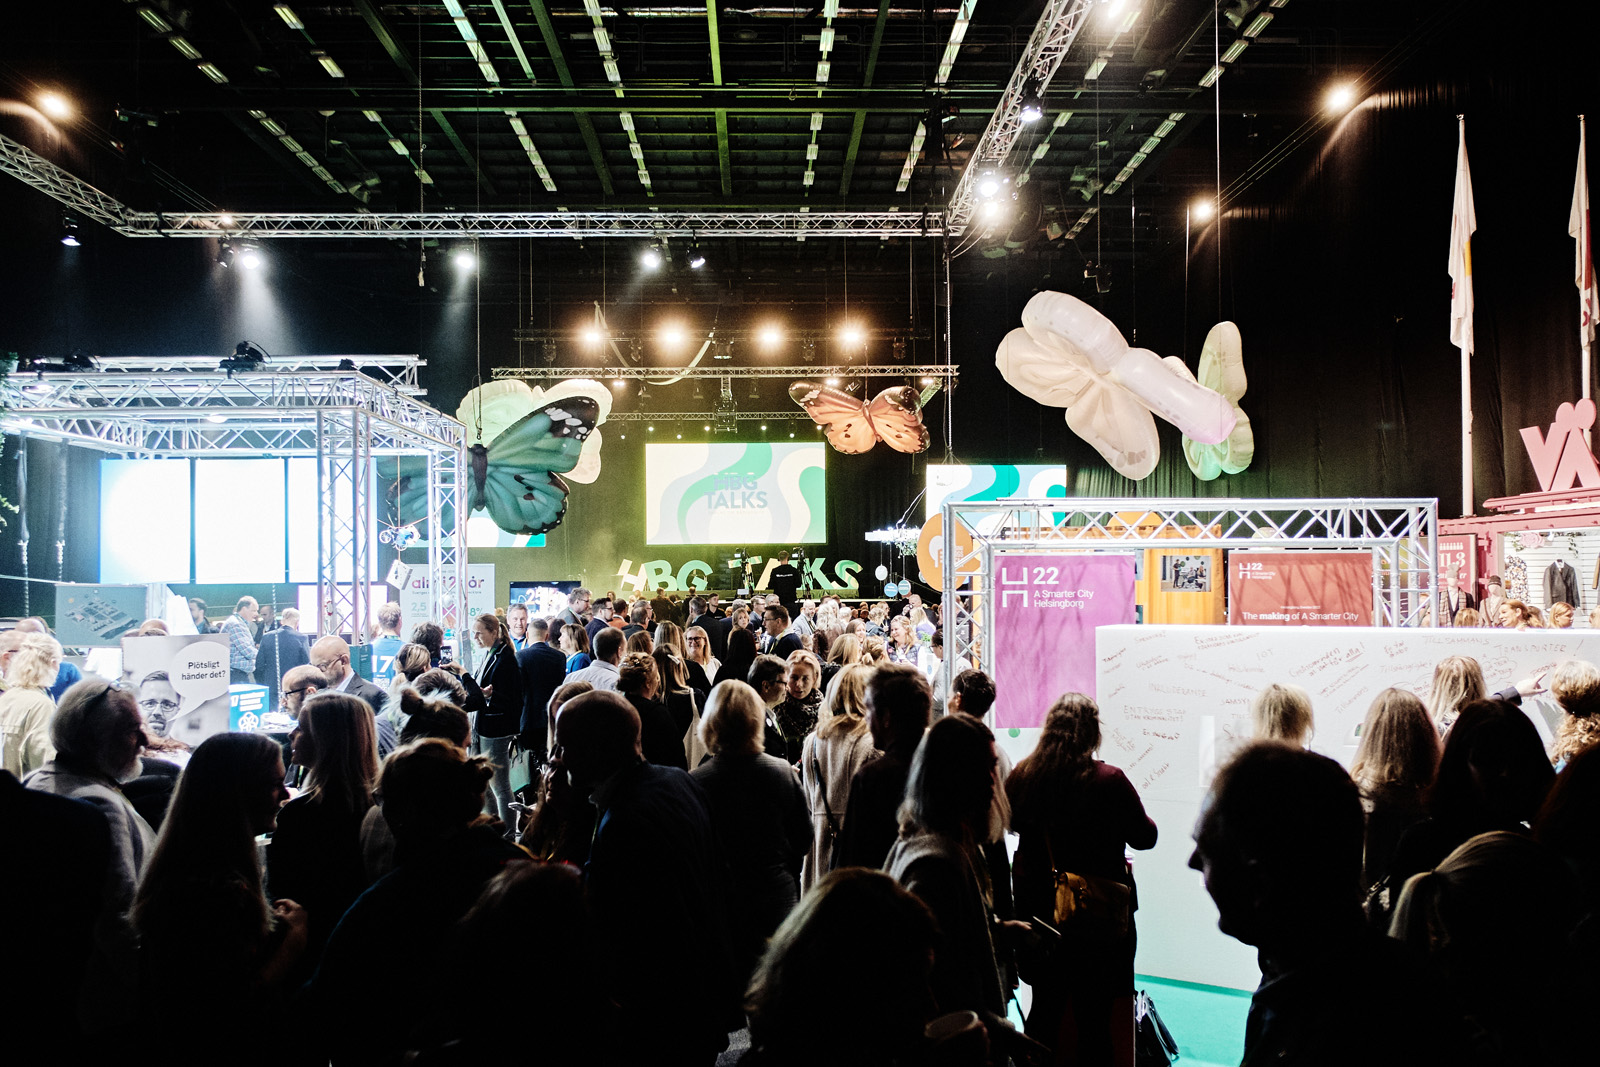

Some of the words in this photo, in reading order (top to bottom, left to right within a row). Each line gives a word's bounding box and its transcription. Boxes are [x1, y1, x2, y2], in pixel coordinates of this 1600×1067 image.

[713, 475, 758, 491] HBG
[704, 491, 769, 509] TALKS
[1251, 562, 1263, 571] 22
[615, 558, 713, 591] HBG
[728, 556, 864, 590] TAKS
[1032, 566, 1059, 585] 22
[1033, 590, 1041, 598] A
[1042, 589, 1075, 598] Smarter
[1077, 588, 1094, 600] City
[1034, 600, 1084, 610] Helsingborg
[1242, 612, 1258, 620] The
[1259, 612, 1290, 622] making
[1291, 612, 1300, 620] of
[1301, 612, 1308, 620] A
[1309, 612, 1341, 620] Smarter
[1343, 612, 1359, 622] City
[188, 660, 220, 670] Plötsligt
[371, 654, 395, 673] 17
[181, 673, 208, 681] händer
[209, 670, 226, 679] det?
